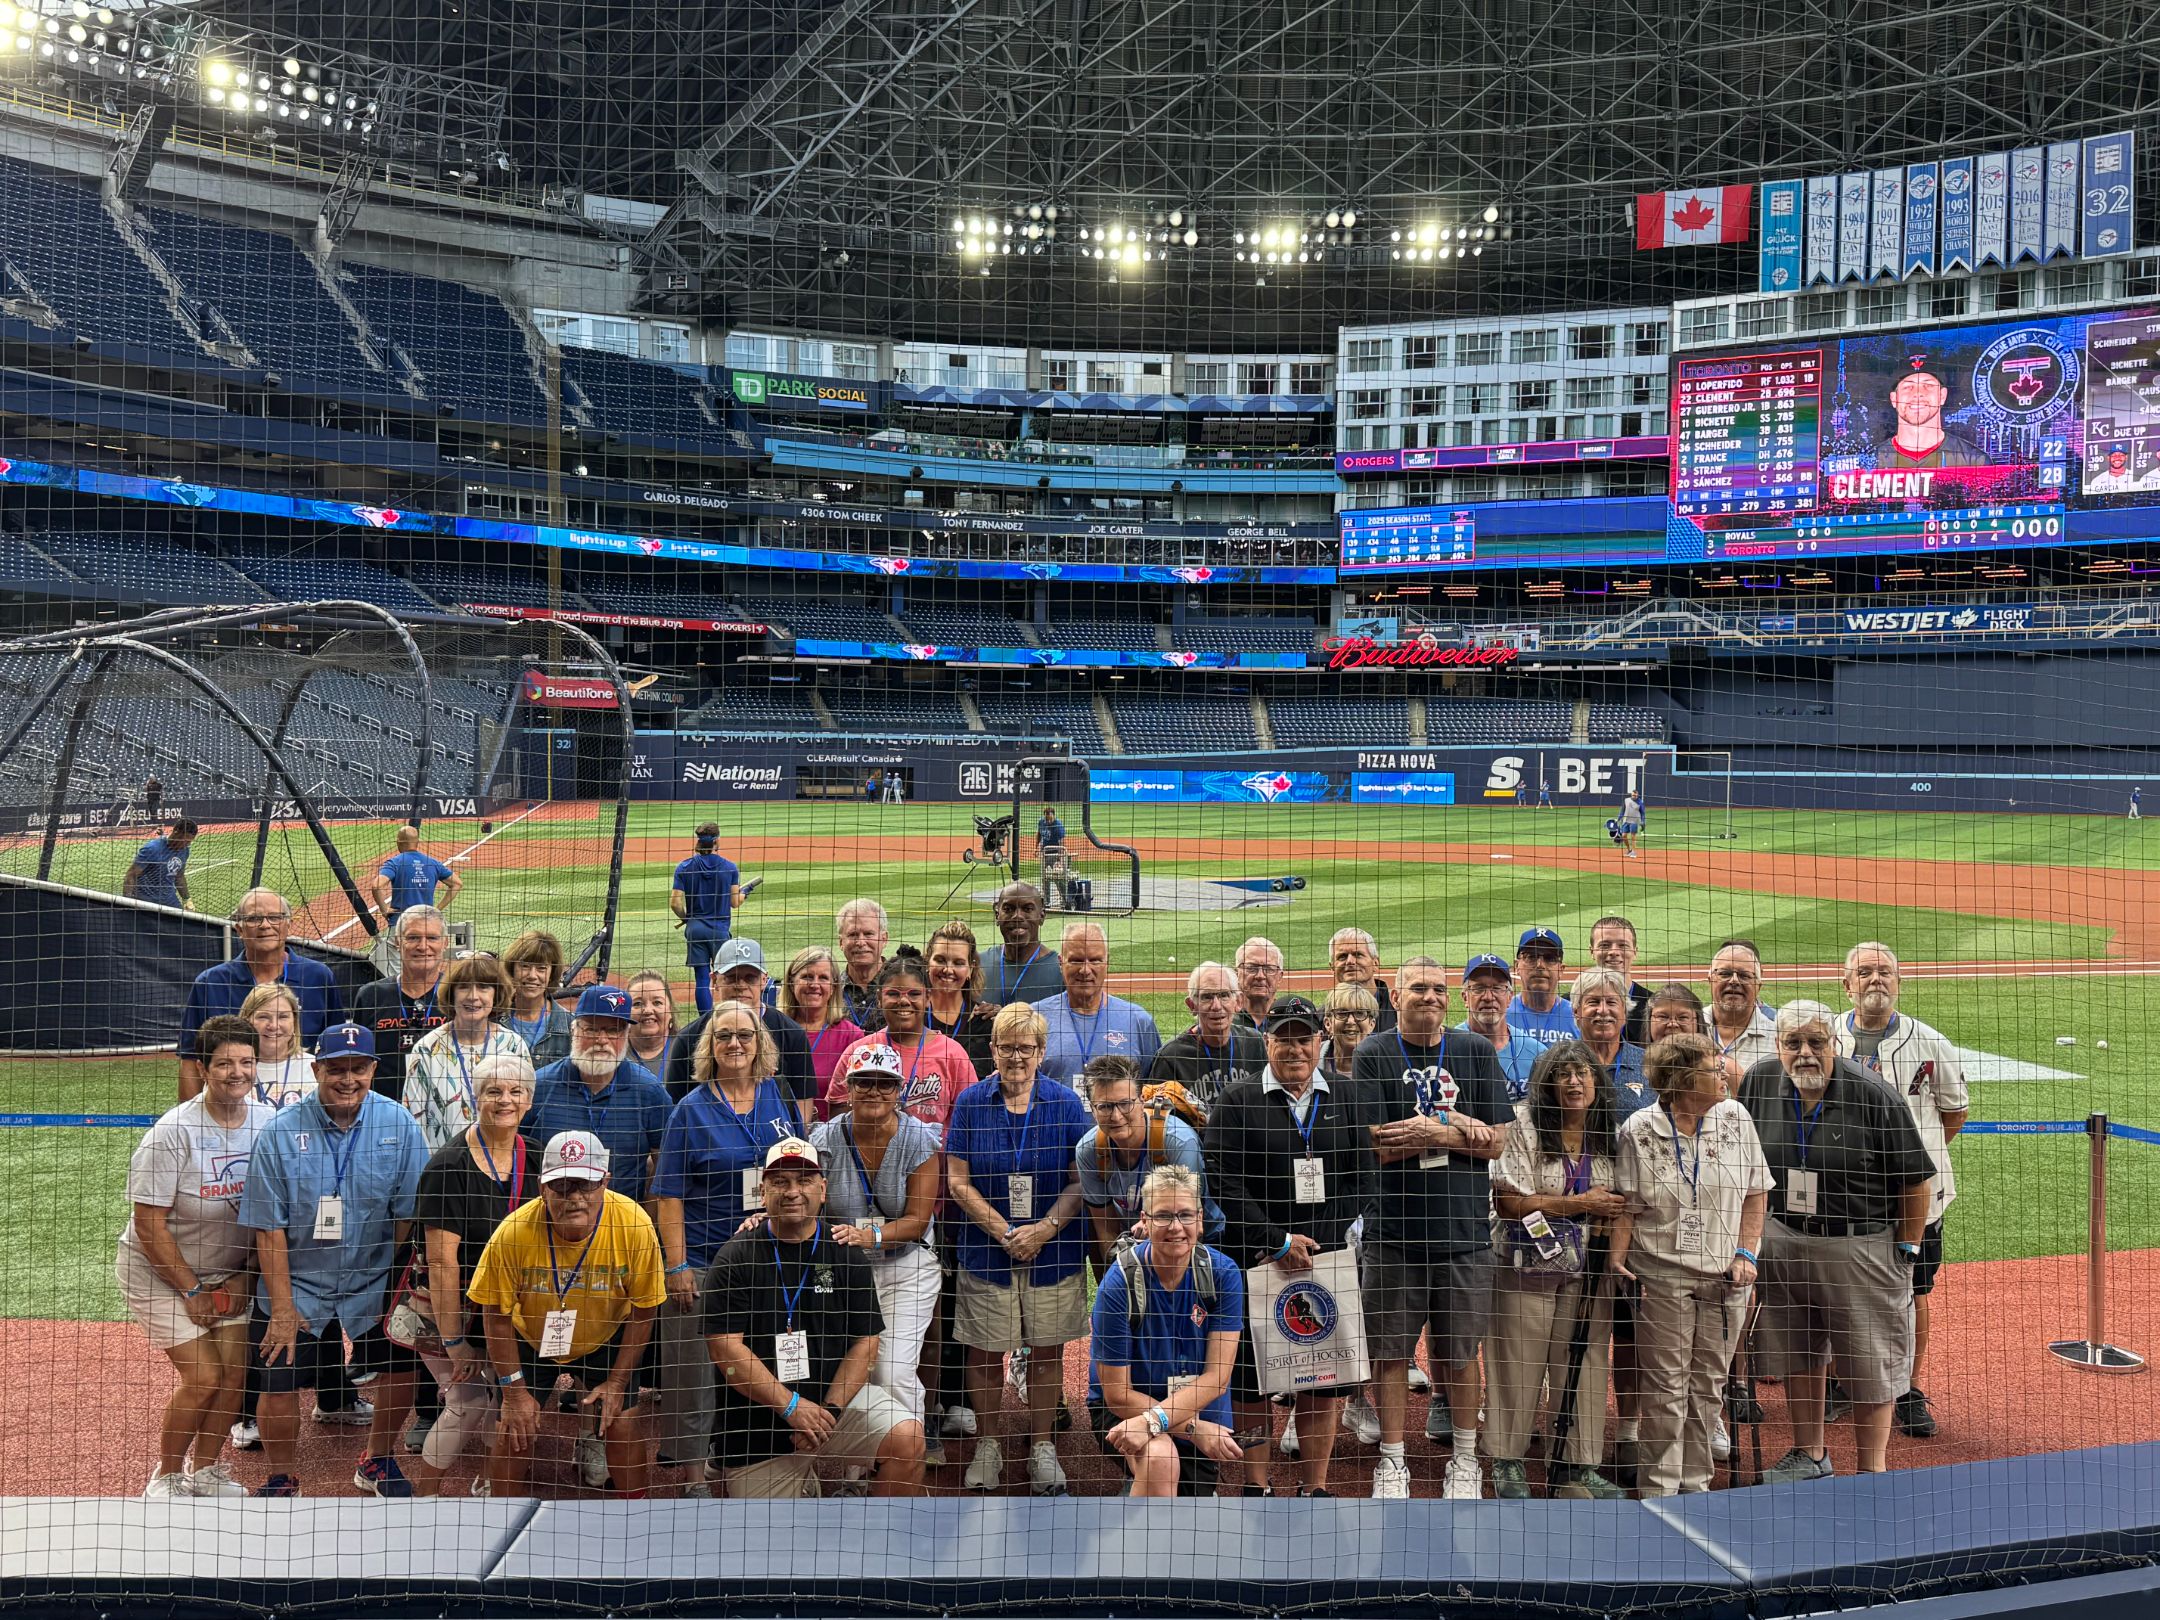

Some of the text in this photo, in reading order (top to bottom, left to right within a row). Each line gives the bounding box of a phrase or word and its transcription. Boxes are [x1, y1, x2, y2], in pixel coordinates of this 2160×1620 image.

[1979, 195, 2004, 210] 2015
[2015, 190, 2040, 205] 2016
[2086, 184, 2129, 216] 32
[1909, 203, 1932, 220] 1992
[1945, 198, 1969, 215] 1993
[1811, 216, 1832, 230] 1985
[1844, 212, 1864, 227] 1989
[1876, 208, 1897, 224] 1991
[1945, 216, 1969, 227] WORLD
[1909, 220, 1932, 230] WORLD
[1908, 232, 1931, 243] SERIES
[1945, 228, 1969, 239] SERIES
[1907, 244, 1931, 255] CHAMPS
[1945, 240, 1969, 250] CHAMPS
[2094, 337, 2137, 349] SCHNEIDER
[2111, 358, 2148, 369] BICHETTE
[1681, 373, 1813, 392] 10 LOPERFIDO RF 1.032 1B
[2106, 376, 2137, 386] BARGER
[735, 377, 868, 402] TD PARK SOCIAL
[1680, 387, 1795, 404] 22 CLEMENT 2B .696
[1680, 400, 1794, 416] 27 GUERRERO JR. 1B .863
[1682, 412, 1794, 428] 11 BICHETTE SS .785
[1679, 432, 1691, 440] 47
[1695, 429, 1728, 440] BARGER
[1759, 426, 1770, 435] 3B
[2114, 426, 2146, 437] DUE UP
[1678, 436, 1793, 452] 36 SCHNEIDER LF .755
[2043, 440, 2062, 457] 22
[1355, 455, 1395, 467] ROGERS
[1681, 449, 1793, 464] 2 FRANCE DH .676
[1680, 461, 1793, 476] 3 STRAW CF .635
[1828, 457, 1861, 472] ERNIE
[1678, 479, 1689, 488] 20
[1693, 475, 1732, 488] SÁNCHEZ
[1761, 475, 1767, 483] C
[1773, 473, 1793, 483] .566
[2043, 466, 2062, 484] 2B
[1833, 472, 1935, 500] CLEMENT
[644, 491, 728, 509] CARLOS DELGADO
[1678, 498, 1813, 514] 104 5 31 .279 .315 .381
[801, 508, 882, 523] 4306 TOM CHEEK
[1368, 517, 1384, 525] 2025
[1386, 515, 1410, 524] SEASON
[1412, 514, 1432, 522] STATS
[943, 518, 1024, 531] TONY FERNANDEZ
[1088, 526, 1144, 535] JOE CARTER
[1227, 527, 1288, 537] GEORGE BELL
[1725, 531, 1756, 541] ROYALS
[569, 533, 606, 548] lights
[607, 538, 627, 550] up
[700, 547, 718, 557] go
[1707, 540, 1776, 555] 3 TORONTO
[474, 605, 509, 616] ROGERS
[553, 611, 683, 629] Proud owner of the Blue Jays
[720, 623, 751, 632] ROGERS
[1846, 610, 2030, 633] WESTJET FLIGHT
[1990, 620, 2025, 630] DECK
[1322, 637, 1518, 668] Budweiser
[545, 687, 613, 699] BeautiTone
[636, 690, 660, 702] RETHINK
[806, 754, 895, 763] CLEAResult Canada
[1358, 753, 1436, 770] PIZZA NOVA
[1558, 757, 1648, 795] BET
[732, 782, 778, 790] Car Rental
[1910, 782, 1932, 793] 400
[317, 804, 407, 815] everywhere you want
[435, 799, 477, 815] VISA
[90, 809, 109, 823] BET
[165, 808, 182, 819] BOX
[736, 943, 750, 958] KC
[1481, 953, 1497, 963] KC
[377, 1018, 412, 1028] SPAC
[342, 1028, 359, 1045] T
[403, 1035, 414, 1044] H
[1540, 1029, 1573, 1042] BOYS
[871, 1053, 884, 1066] NY
[295, 1133, 310, 1150] T
[1266, 1349, 1356, 1369] SPIRIT of HOCKEY
[1294, 1373, 1336, 1384] HHOF.com
